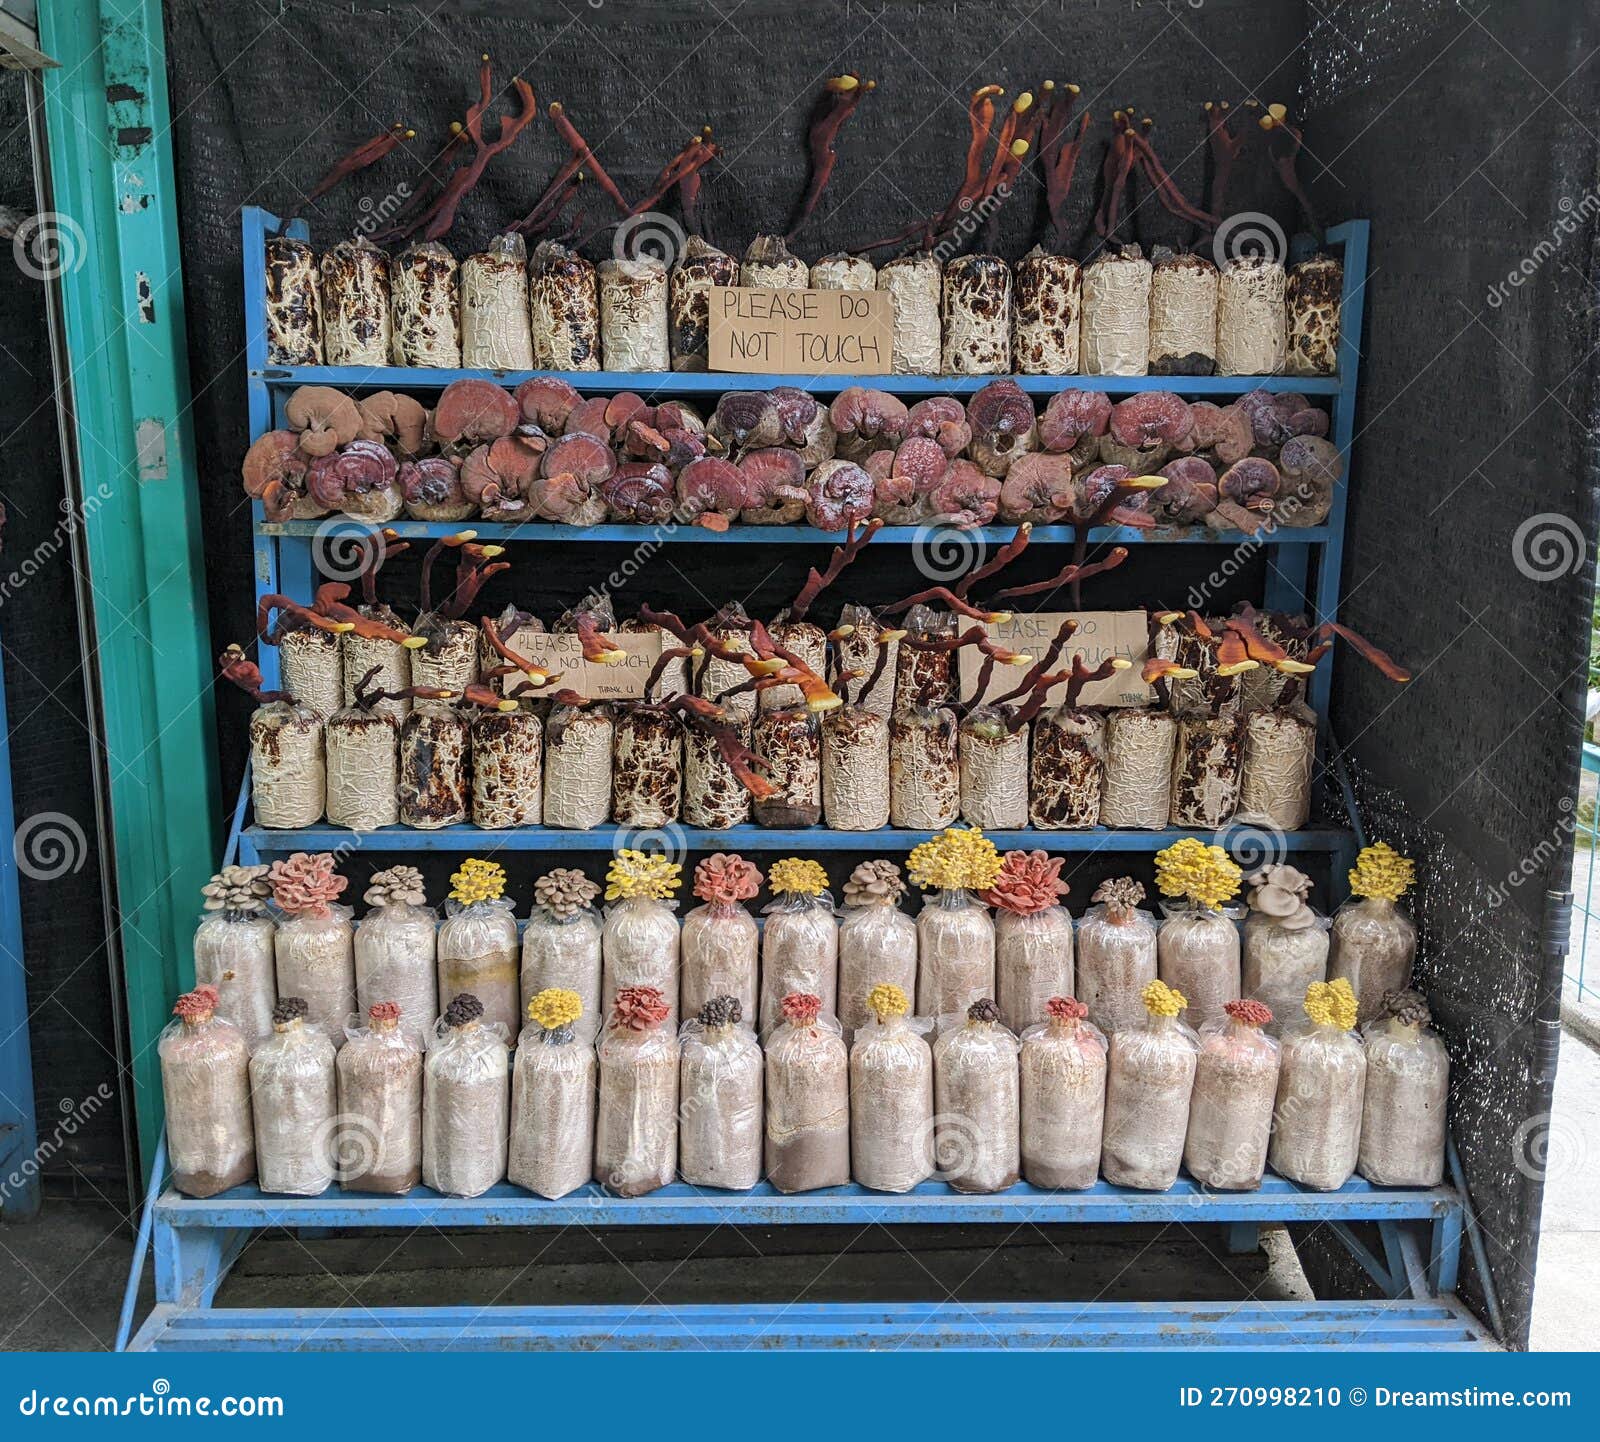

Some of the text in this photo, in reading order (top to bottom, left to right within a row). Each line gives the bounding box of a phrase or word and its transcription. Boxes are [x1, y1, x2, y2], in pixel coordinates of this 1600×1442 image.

[724, 290, 870, 320] PLEASE DO
[730, 330, 881, 364] NOT TOUCH
[975, 619, 1048, 640] LEASE
[518, 633, 581, 652] PLEASE
[559, 656, 588, 669] NOT
